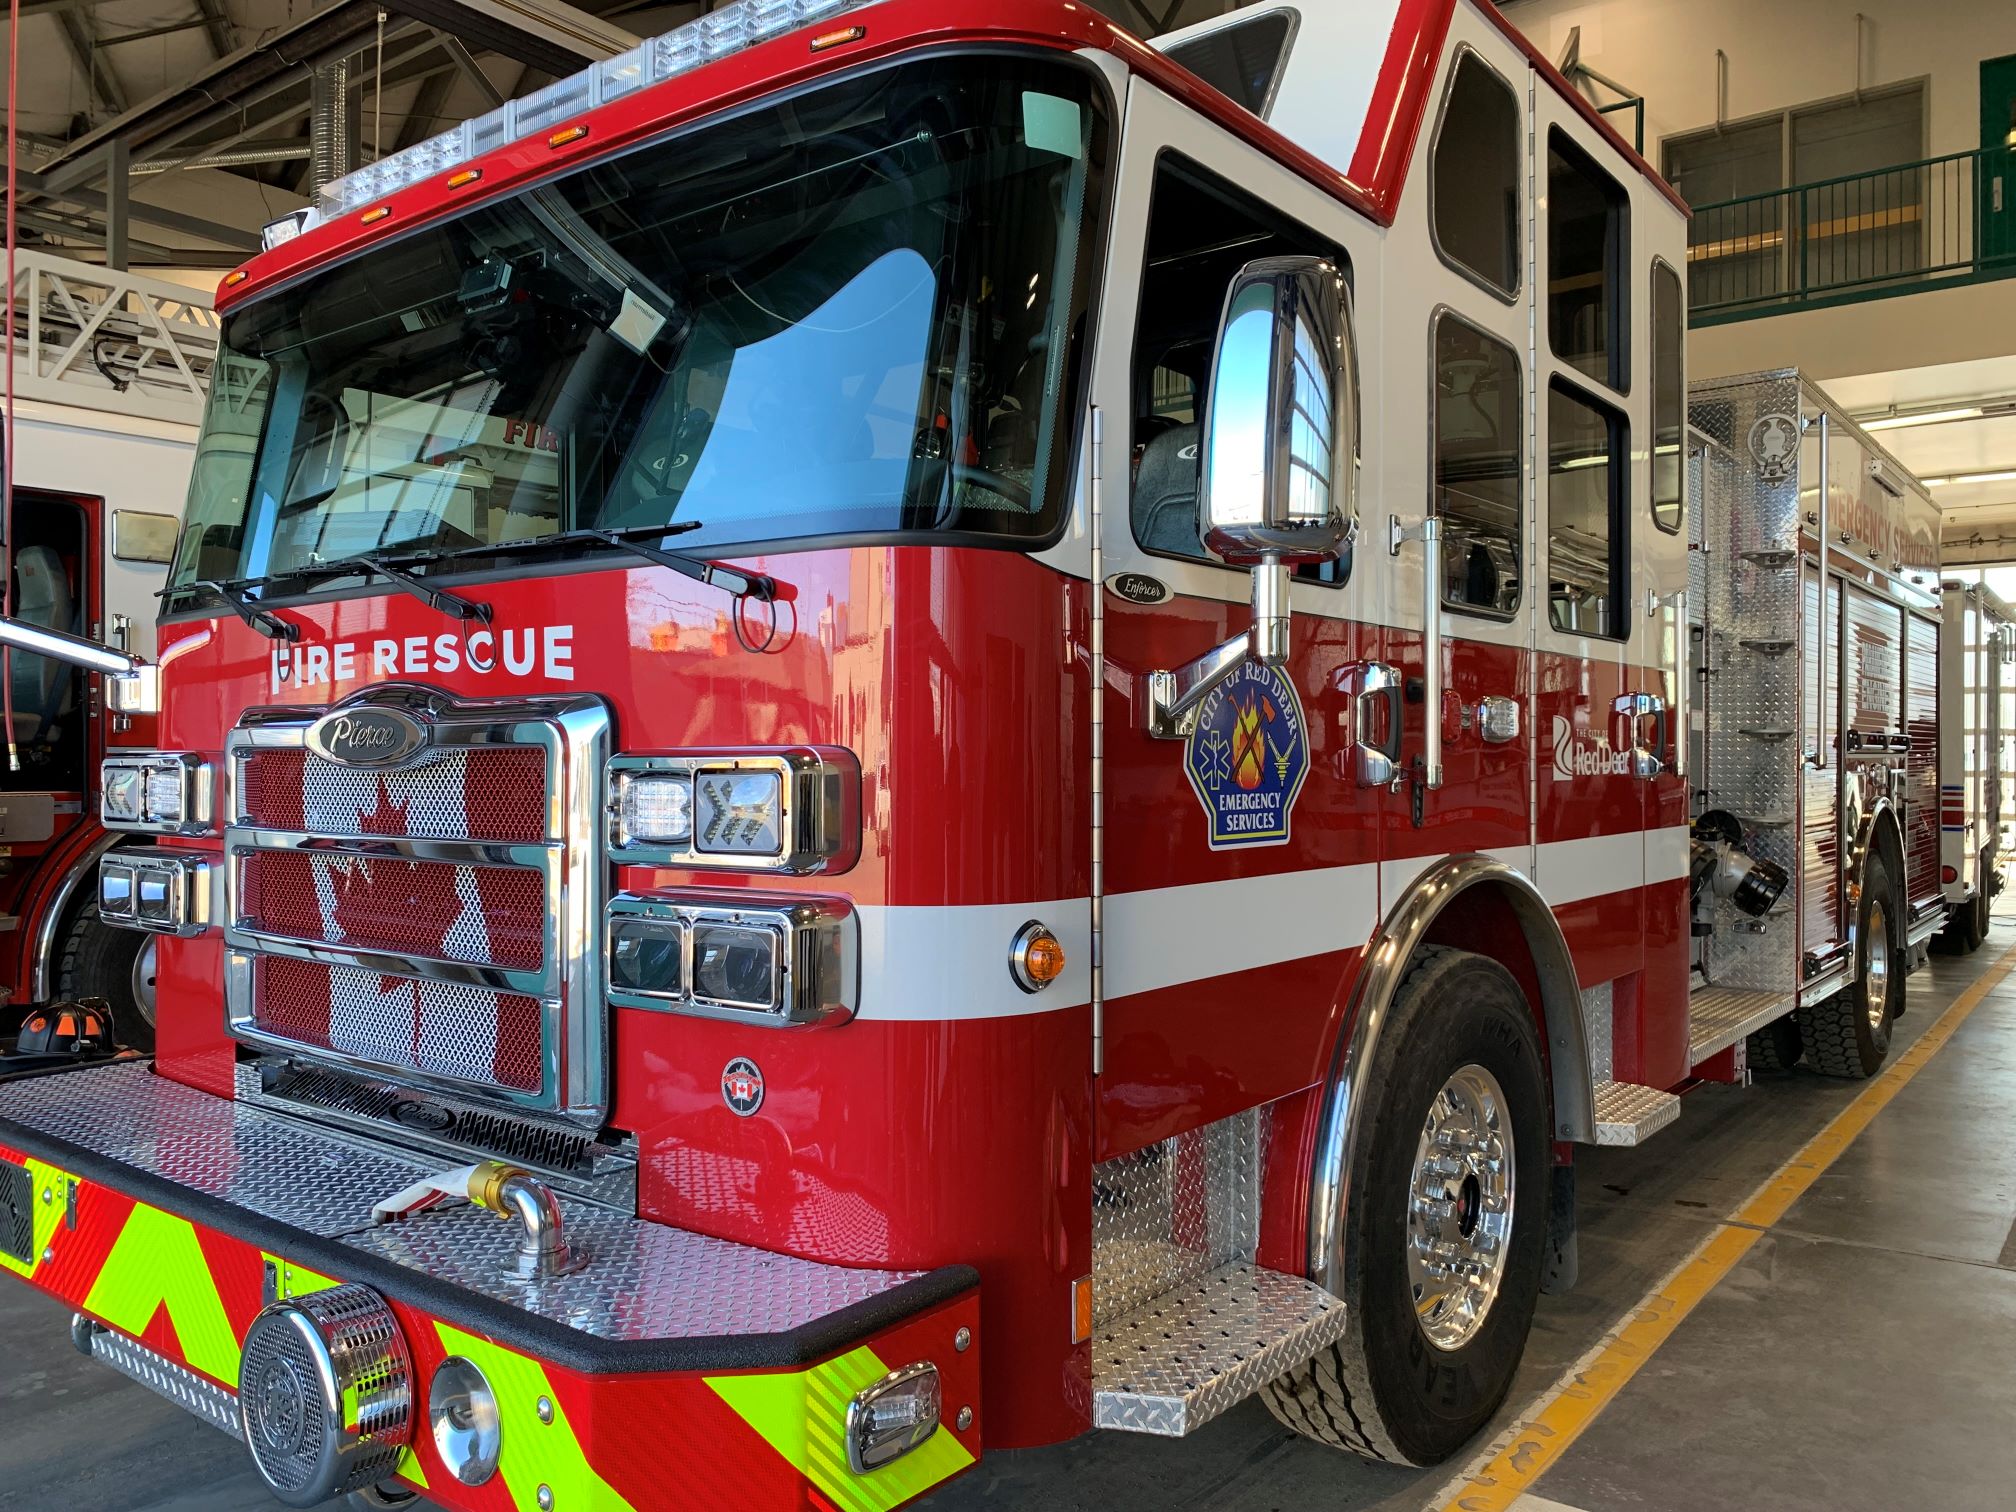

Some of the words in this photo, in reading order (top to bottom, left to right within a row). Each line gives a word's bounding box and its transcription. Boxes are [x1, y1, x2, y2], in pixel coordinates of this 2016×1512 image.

[1828, 491, 1891, 557] MERGENCY
[1124, 577, 1161, 598] Enforcer
[271, 642, 356, 696] FIRE
[373, 624, 575, 682] RESCUE
[1200, 685, 1225, 731] CITY
[1245, 661, 1271, 686] RED
[1271, 677, 1298, 736] DEER
[330, 716, 397, 753] Pierce
[1576, 728, 1587, 738] THE
[1588, 728, 1601, 738] CITY
[1602, 728, 1609, 738] OF
[1576, 741, 1601, 776] Red
[1602, 741, 1630, 776] Deer
[1219, 792, 1281, 811] EMERGENCY
[1226, 812, 1275, 832] SERVICES
